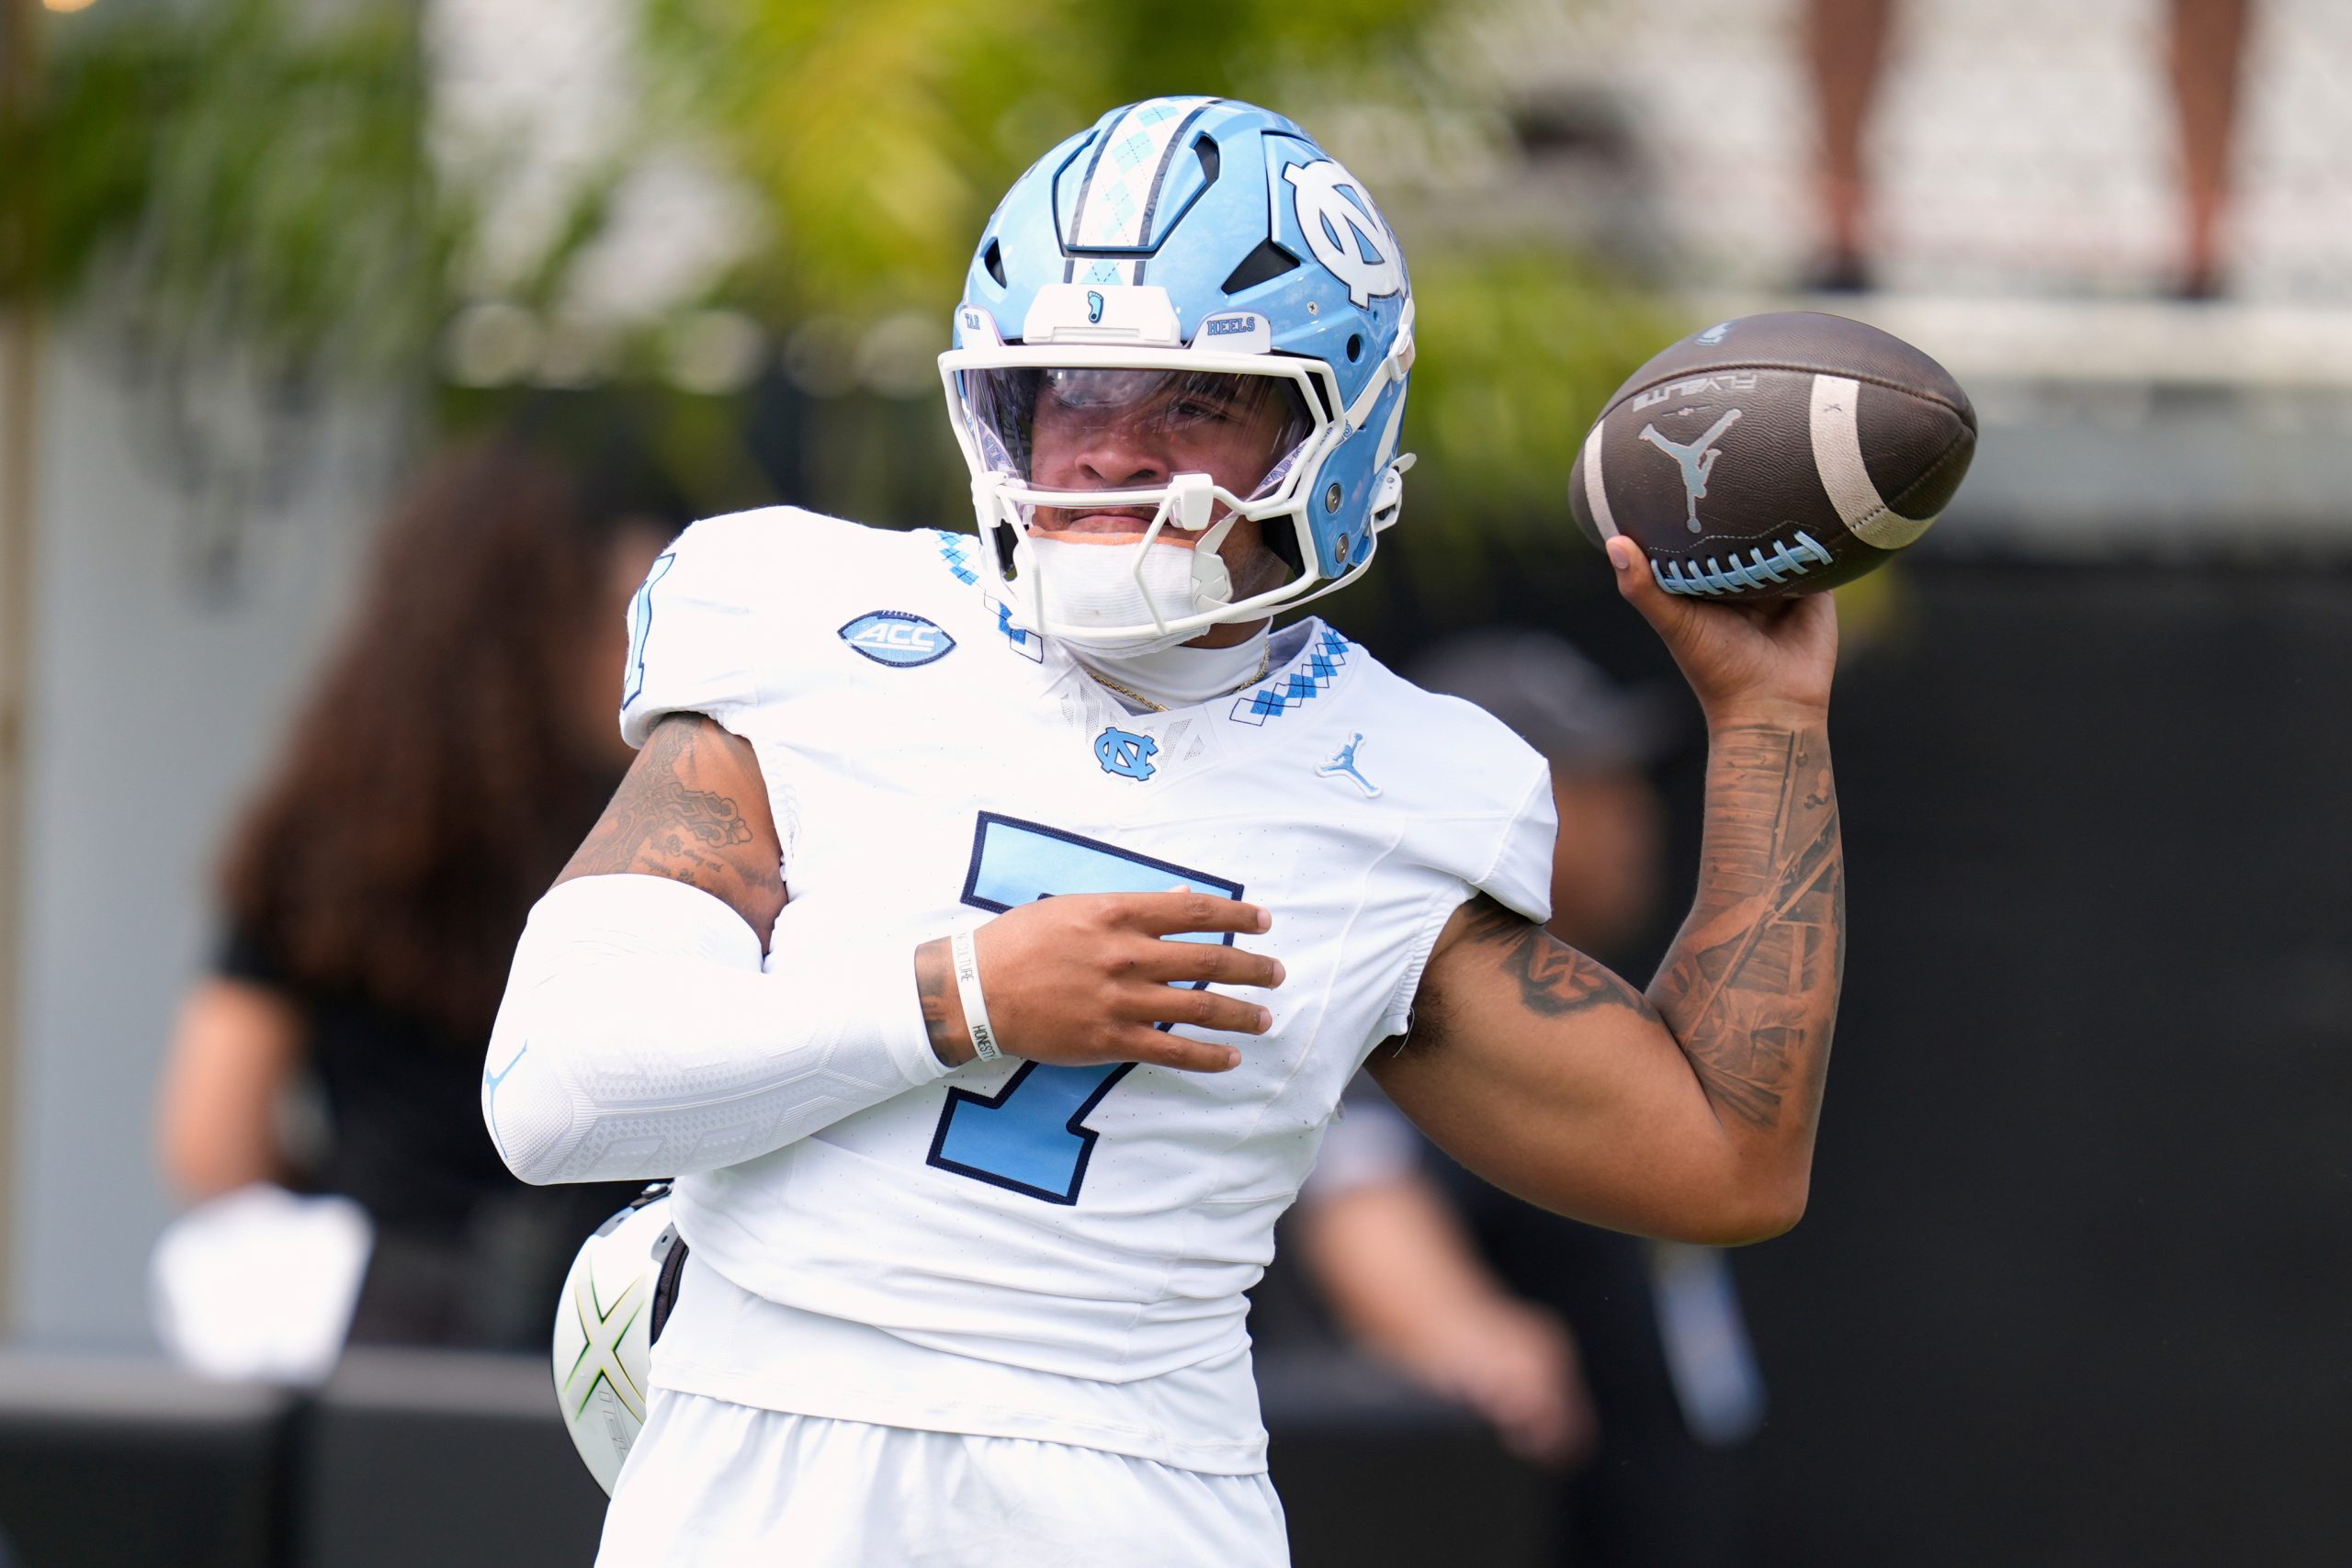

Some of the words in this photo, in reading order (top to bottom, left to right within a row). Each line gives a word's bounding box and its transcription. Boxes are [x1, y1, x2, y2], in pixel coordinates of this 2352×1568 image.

[1206, 316, 1256, 336] HEELS
[852, 622, 942, 648] ACC
[926, 809, 1245, 1207] 7
[972, 1024, 999, 1059] HONESTY
